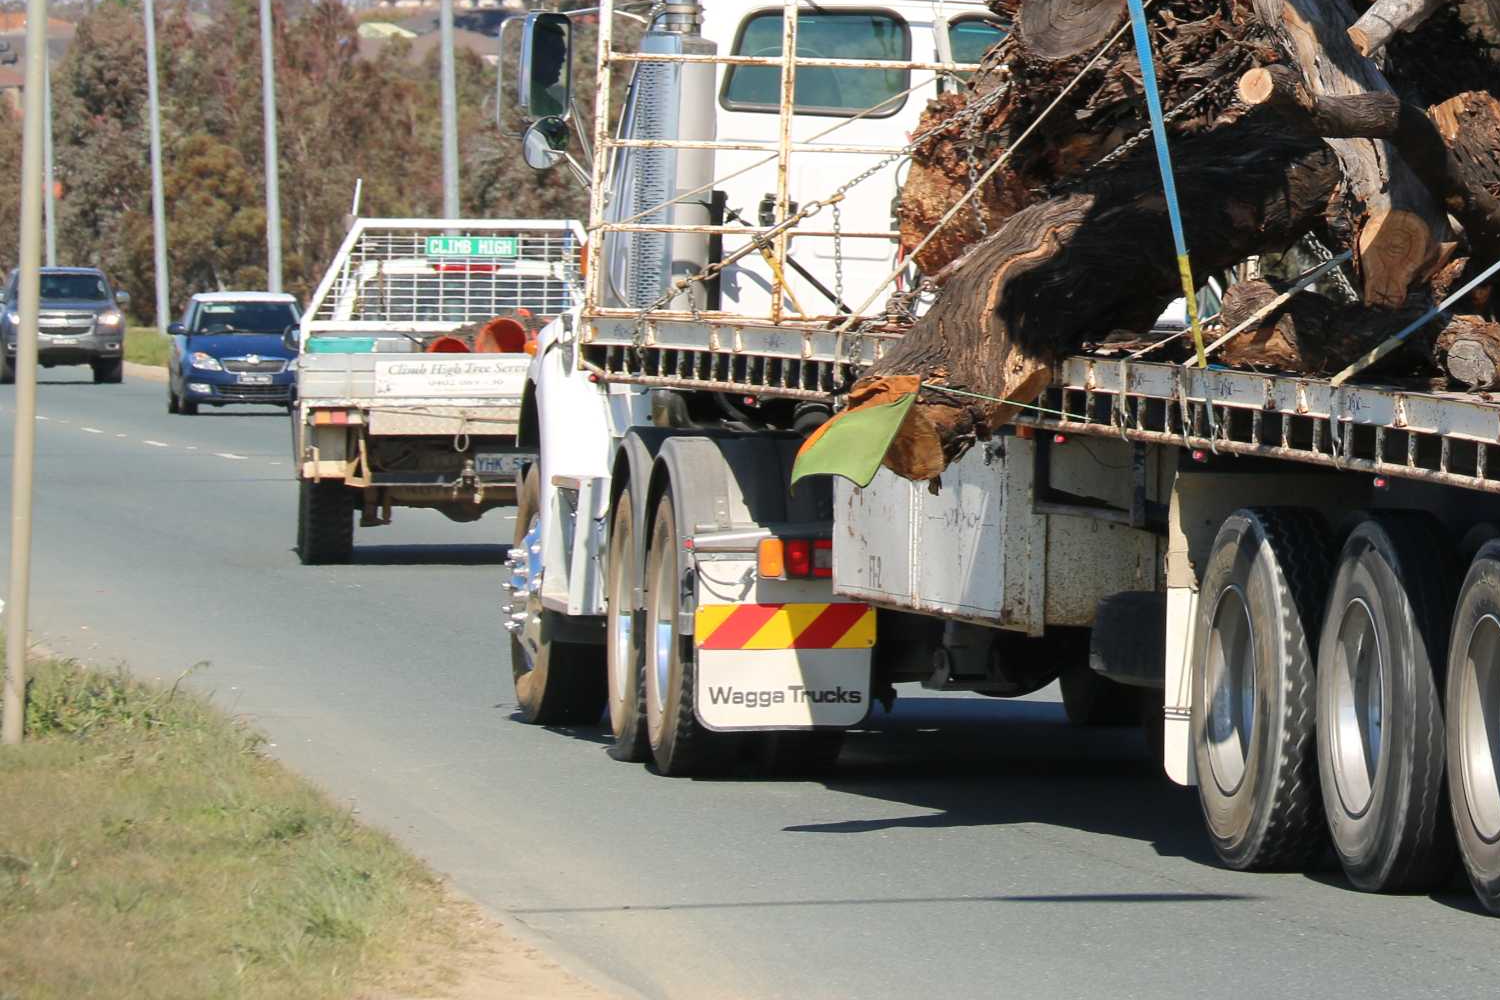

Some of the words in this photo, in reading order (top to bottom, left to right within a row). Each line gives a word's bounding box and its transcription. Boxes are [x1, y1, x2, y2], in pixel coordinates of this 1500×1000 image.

[431, 239, 472, 254] CLIMB
[478, 239, 512, 254] HIGH
[388, 362, 428, 376] Climb
[431, 362, 462, 377] High
[464, 361, 492, 375] Tree
[708, 686, 785, 708] Wagga
[788, 685, 862, 704] Trucks
